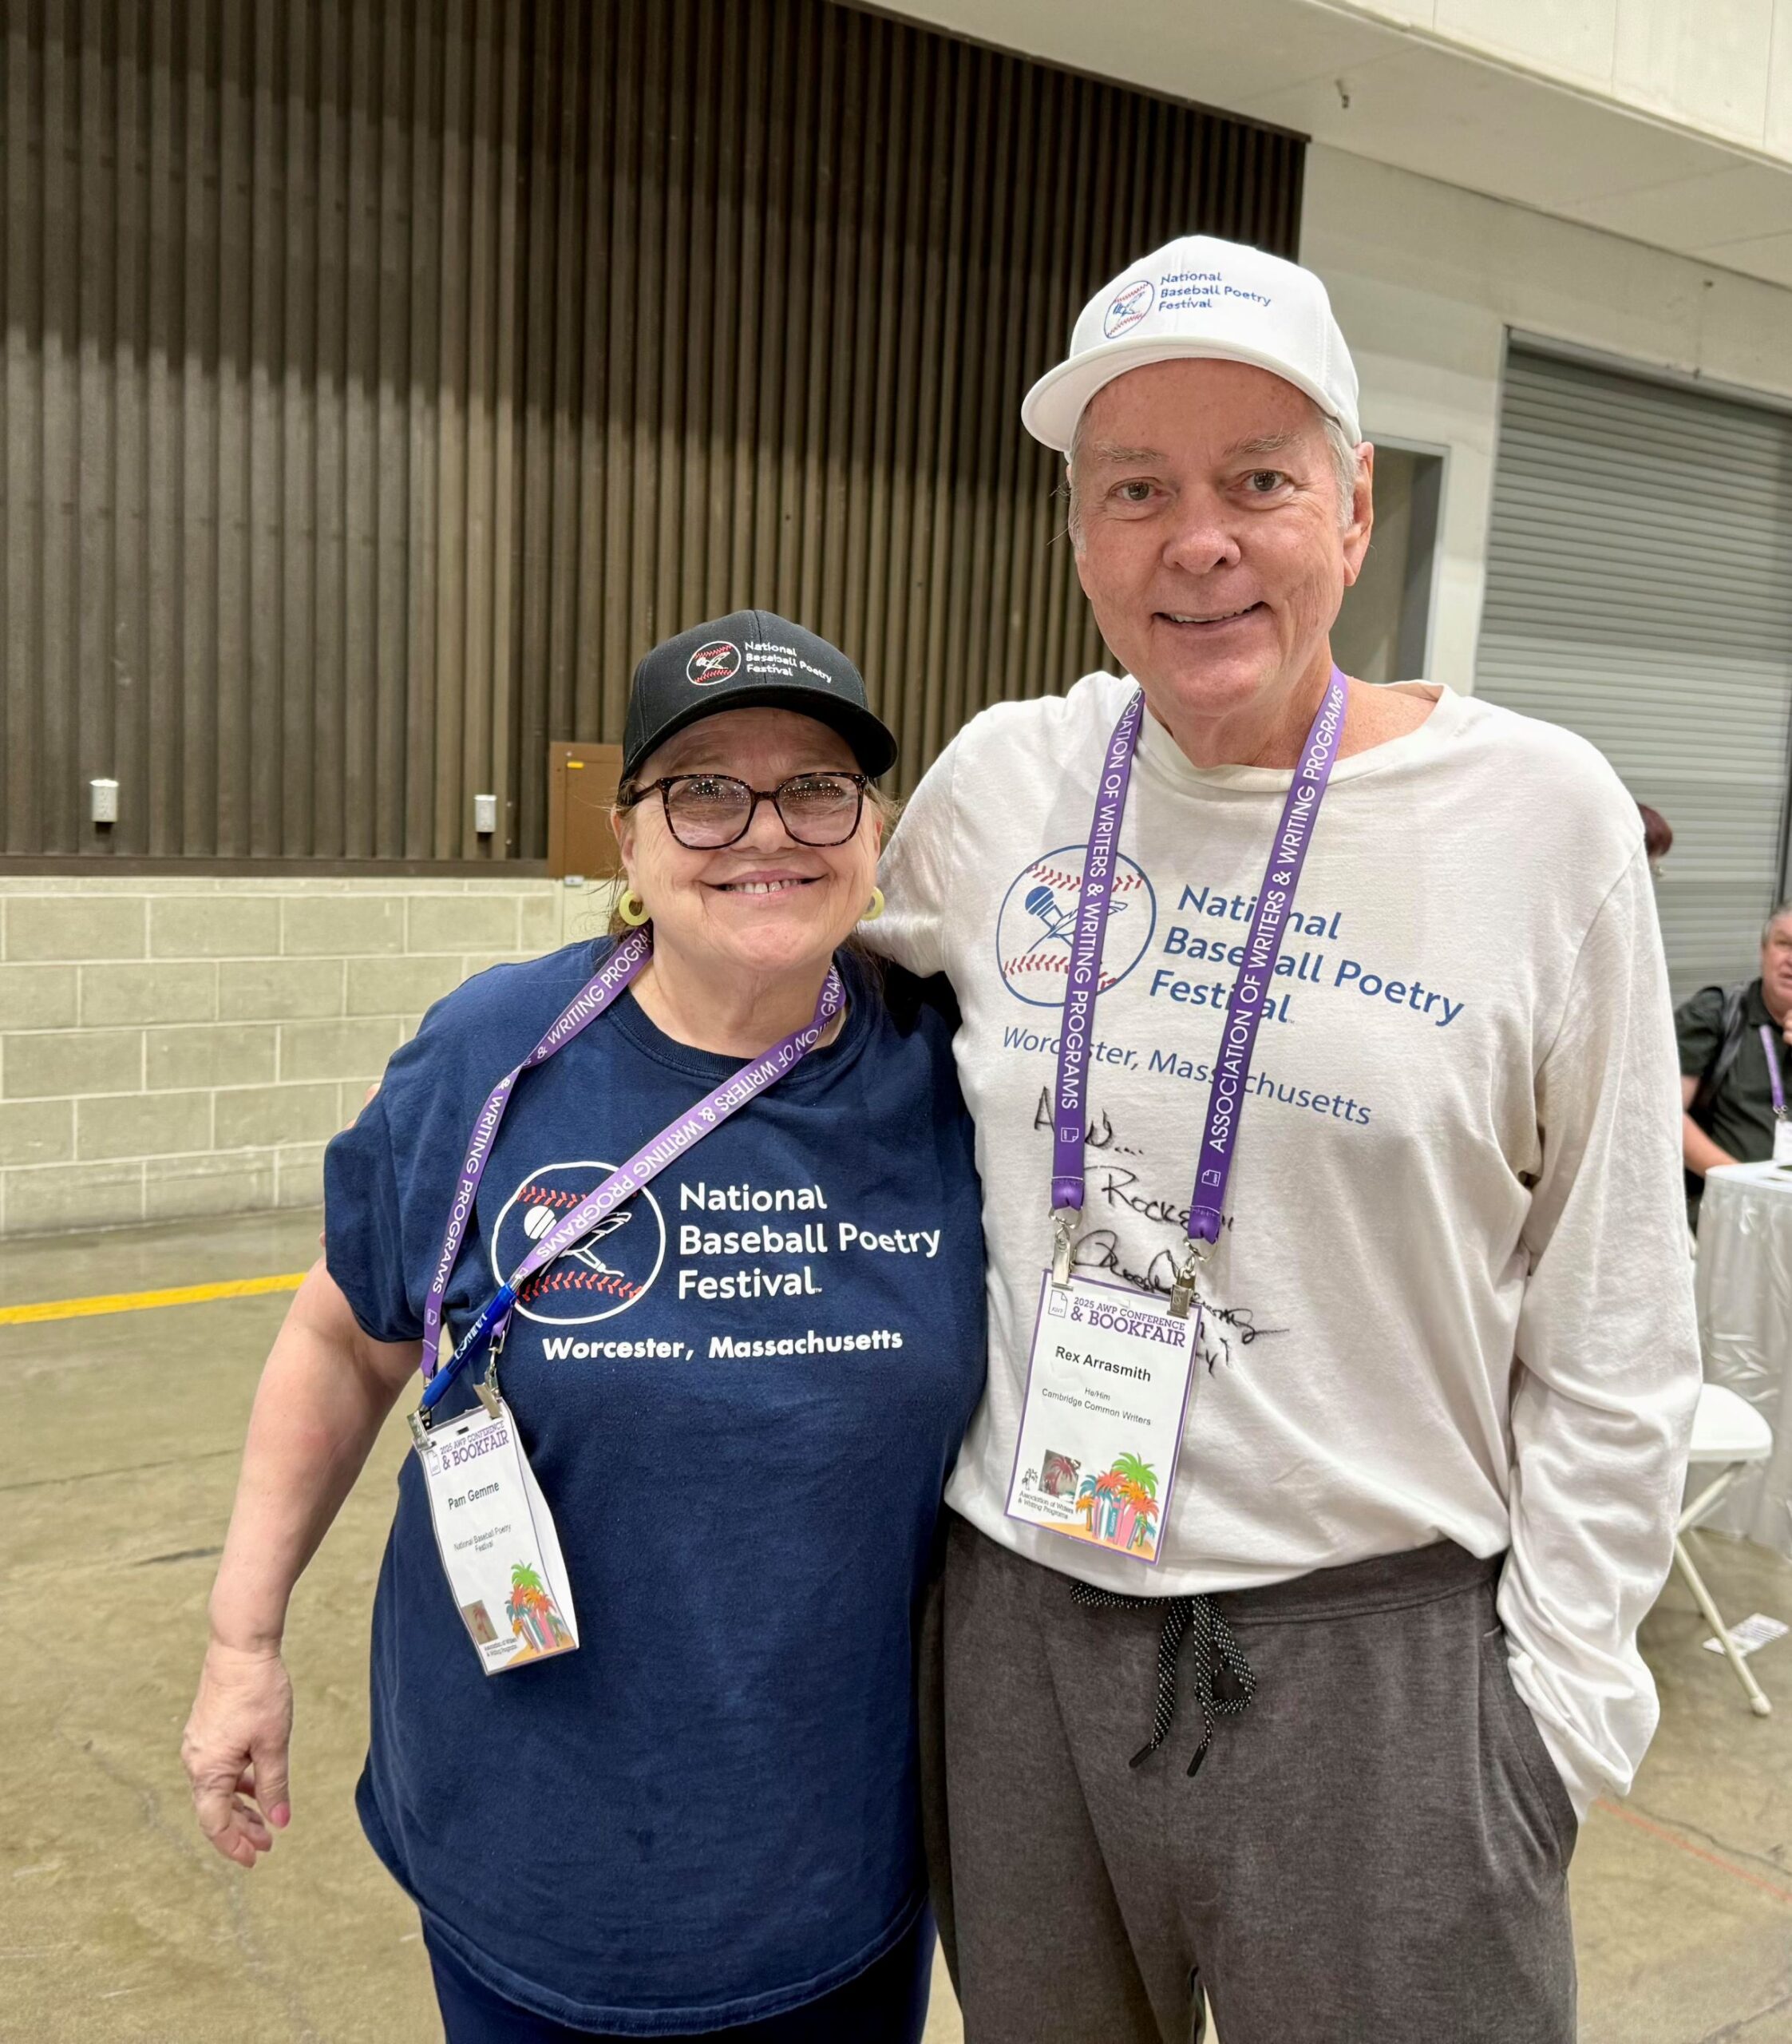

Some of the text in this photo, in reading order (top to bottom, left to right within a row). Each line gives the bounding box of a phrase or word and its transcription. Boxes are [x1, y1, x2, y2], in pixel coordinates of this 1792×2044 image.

[1161, 272, 1223, 285] National
[1161, 285, 1272, 307] Baseball Poetry
[1159, 297, 1212, 311] Festival
[745, 641, 797, 656] National
[746, 652, 832, 683] Baseball Poetry
[746, 664, 794, 676] Festival
[1103, 774, 1121, 798] OF
[1089, 803, 1117, 878] WRITERS
[1086, 882, 1105, 897] &
[1177, 884, 1343, 940] Natinal
[1209, 684, 1343, 1154] ASSOCIATION OF WRITERS & WRITING PROGRAMS
[1071, 901, 1103, 984] WRITING
[1163, 926, 1464, 1027] Baseall Poetry
[548, 984, 605, 1044] WRITING
[1149, 969, 1292, 1023] Festial
[1003, 1026, 1138, 1071] Worcter,
[1060, 990, 1090, 1109] PROGRAMS
[465, 1095, 504, 1175] WRITING
[536, 1044, 793, 1259] OF WRITERS & WRITING PROGRAMS
[679, 1182, 827, 1211] National
[432, 1178, 474, 1295] PROGRAMS
[679, 1222, 941, 1257] Baseball Poetry
[1070, 1305, 1084, 1322] &
[1087, 1309, 1186, 1348] BOOKFAIR
[1074, 1297, 1185, 1331] 2025 AWP CONFERENCE
[542, 1330, 904, 1361] Worcester, Massachusetts
[1055, 1345, 1152, 1382] Rex Arrasmith
[1042, 1388, 1152, 1427] Cambridge Common Writers
[1085, 1387, 1111, 1401] He/Him
[440, 1443, 453, 1455] 2025
[467, 1420, 505, 1443] CONFERENCE
[442, 1429, 509, 1471] & BOOKFAIR
[448, 1481, 500, 1510] Pam Gemme
